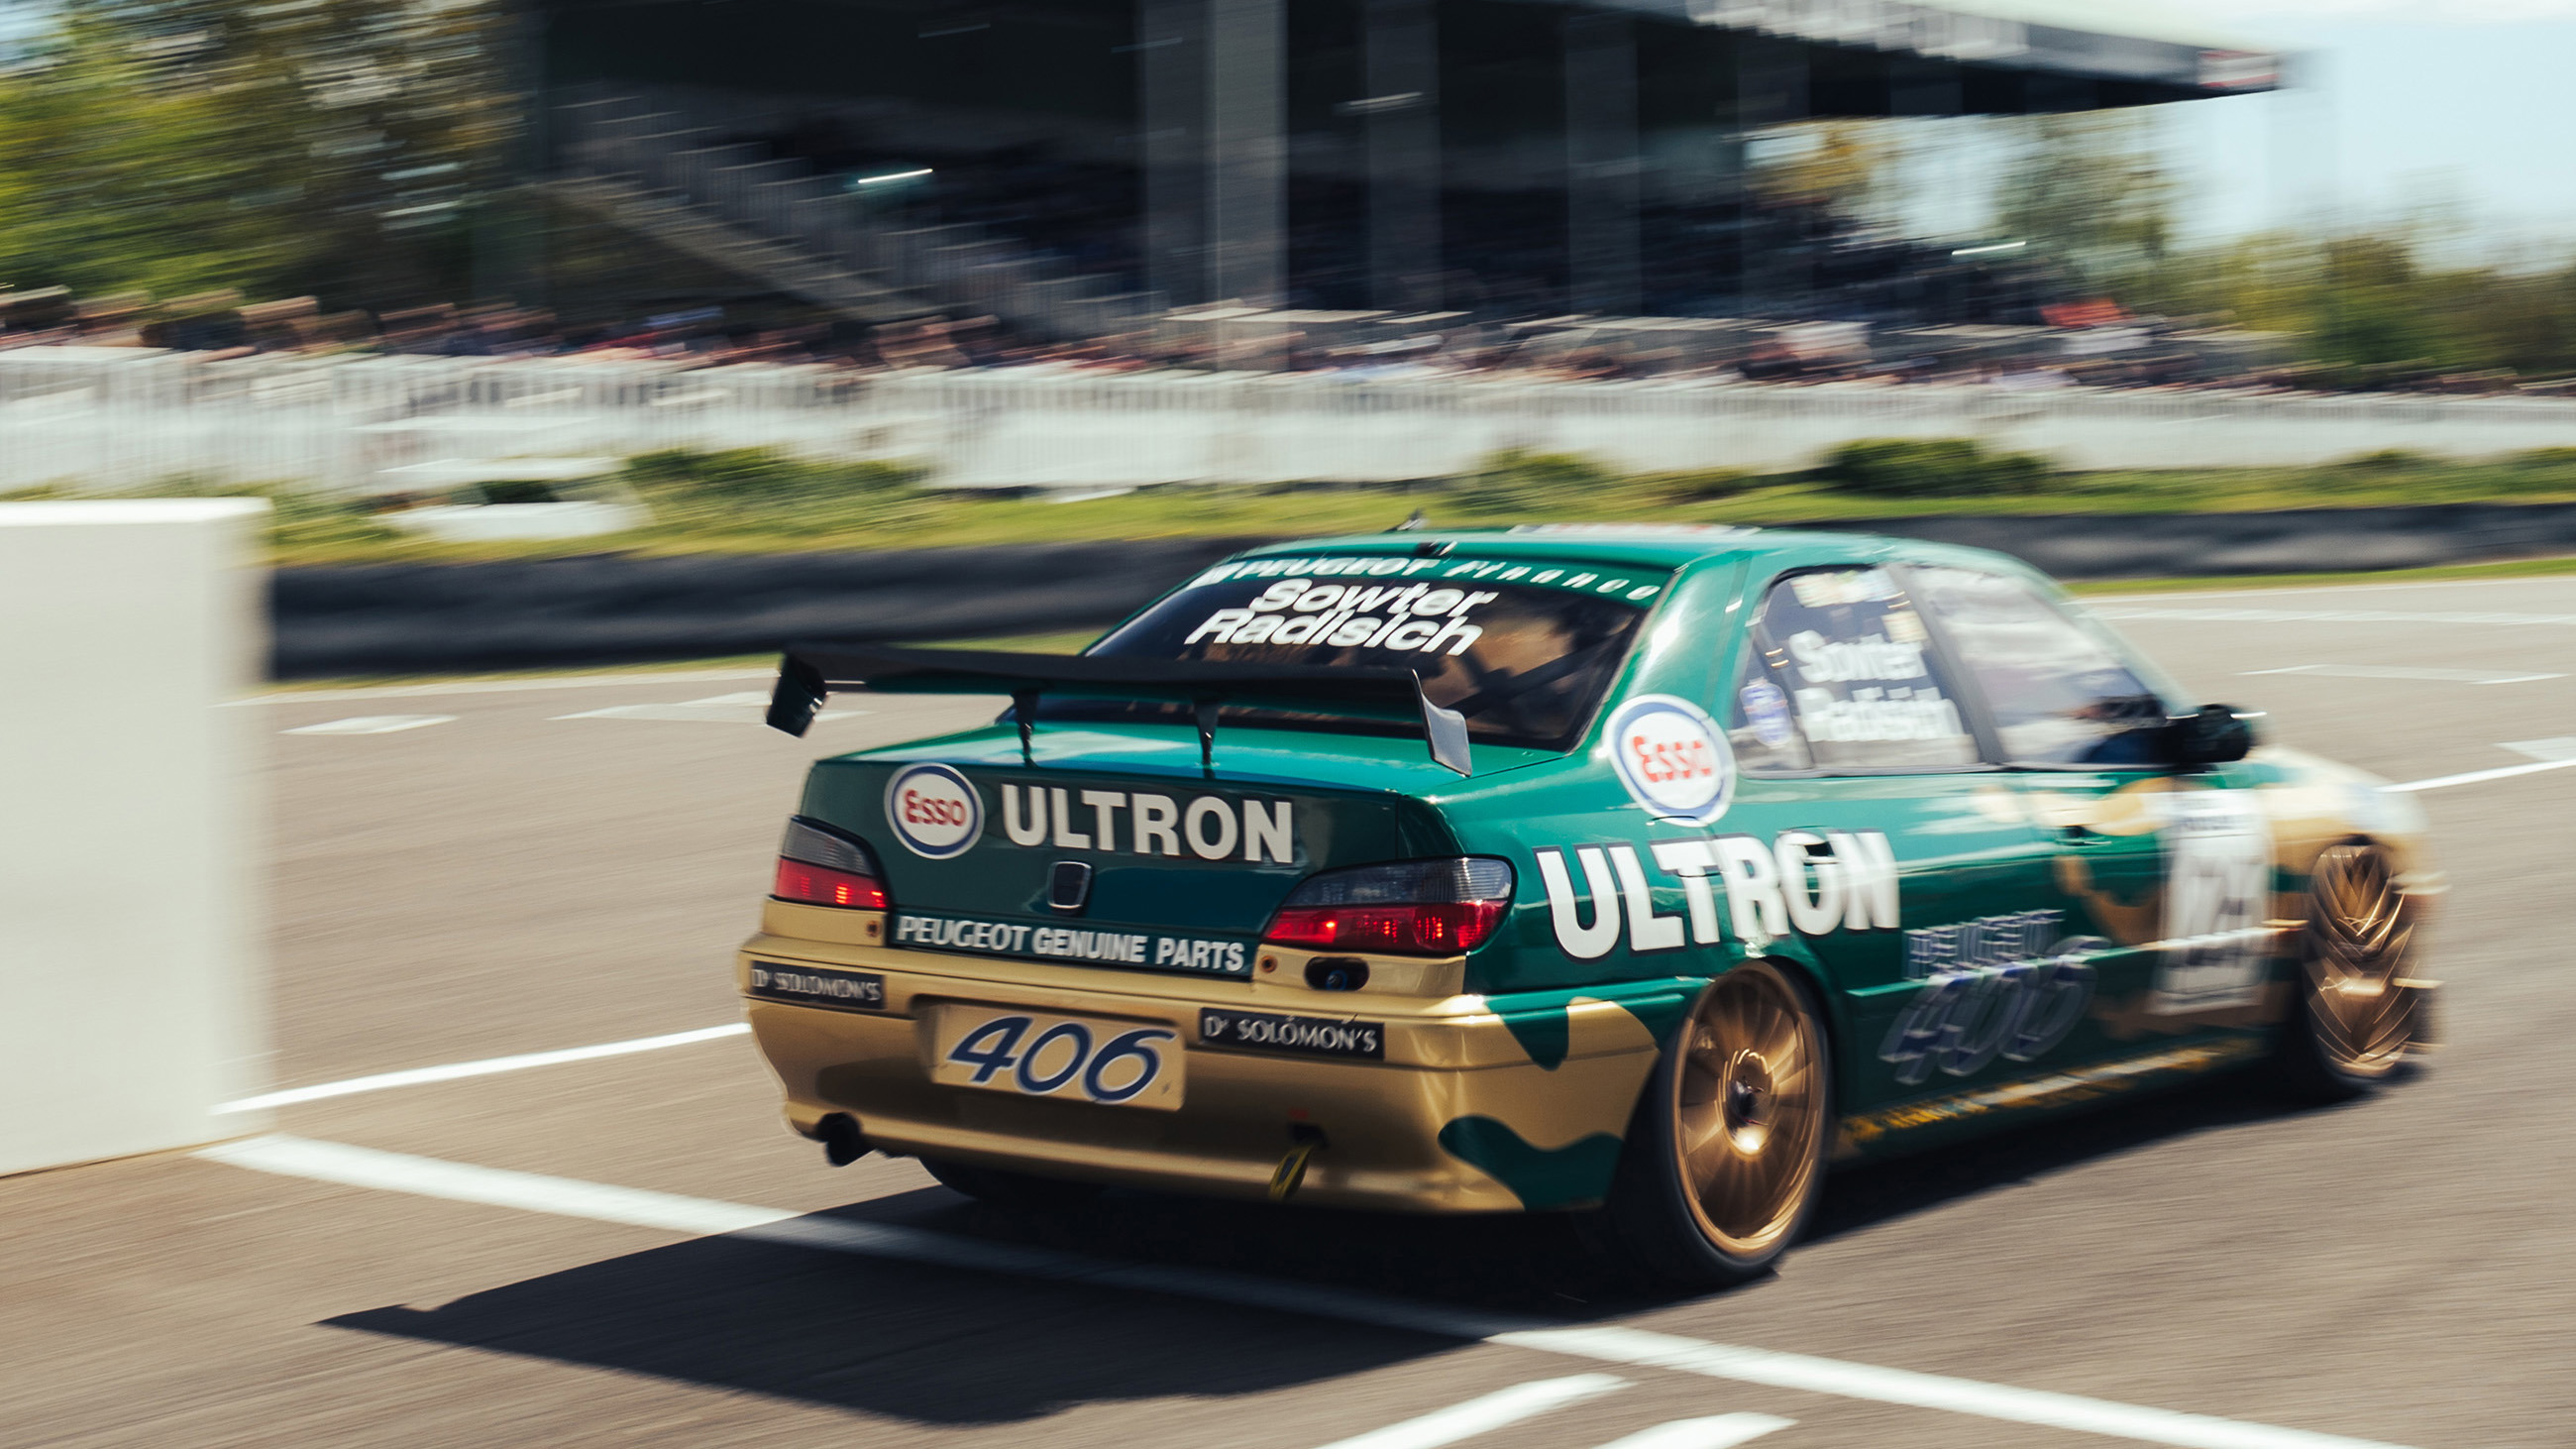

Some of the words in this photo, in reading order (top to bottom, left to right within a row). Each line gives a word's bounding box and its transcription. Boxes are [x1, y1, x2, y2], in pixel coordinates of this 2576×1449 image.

[1233, 557, 1441, 580] PEUGEOT
[1248, 578, 1500, 617] Sowter
[1183, 608, 1484, 656] Radisich
[1001, 783, 1294, 864] ULTRON
[1534, 829, 1901, 960] ULTRON
[896, 915, 1031, 952] PEUGEOT
[1031, 927, 1146, 963] GENUINE
[1154, 937, 1245, 972] PARTS
[948, 1014, 1179, 1106] 406
